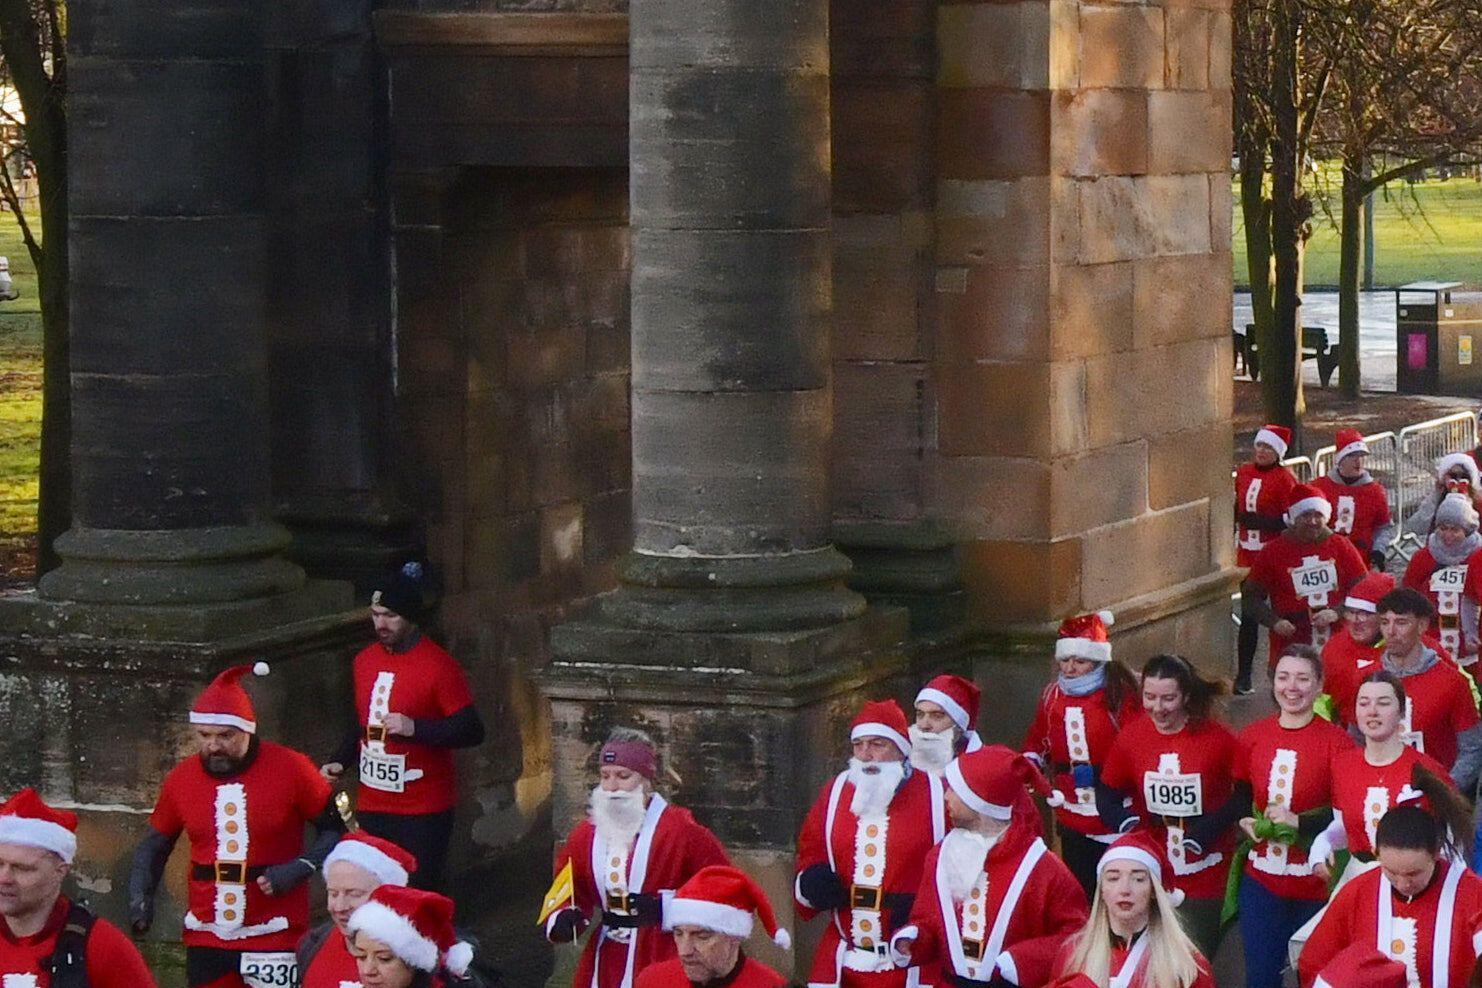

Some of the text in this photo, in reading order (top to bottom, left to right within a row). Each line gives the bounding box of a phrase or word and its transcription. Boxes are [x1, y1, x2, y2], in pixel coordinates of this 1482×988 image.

[1302, 569, 1329, 586] 450
[1439, 570, 1466, 584] 451
[362, 757, 399, 782] 2155
[1149, 783, 1197, 805] 1985
